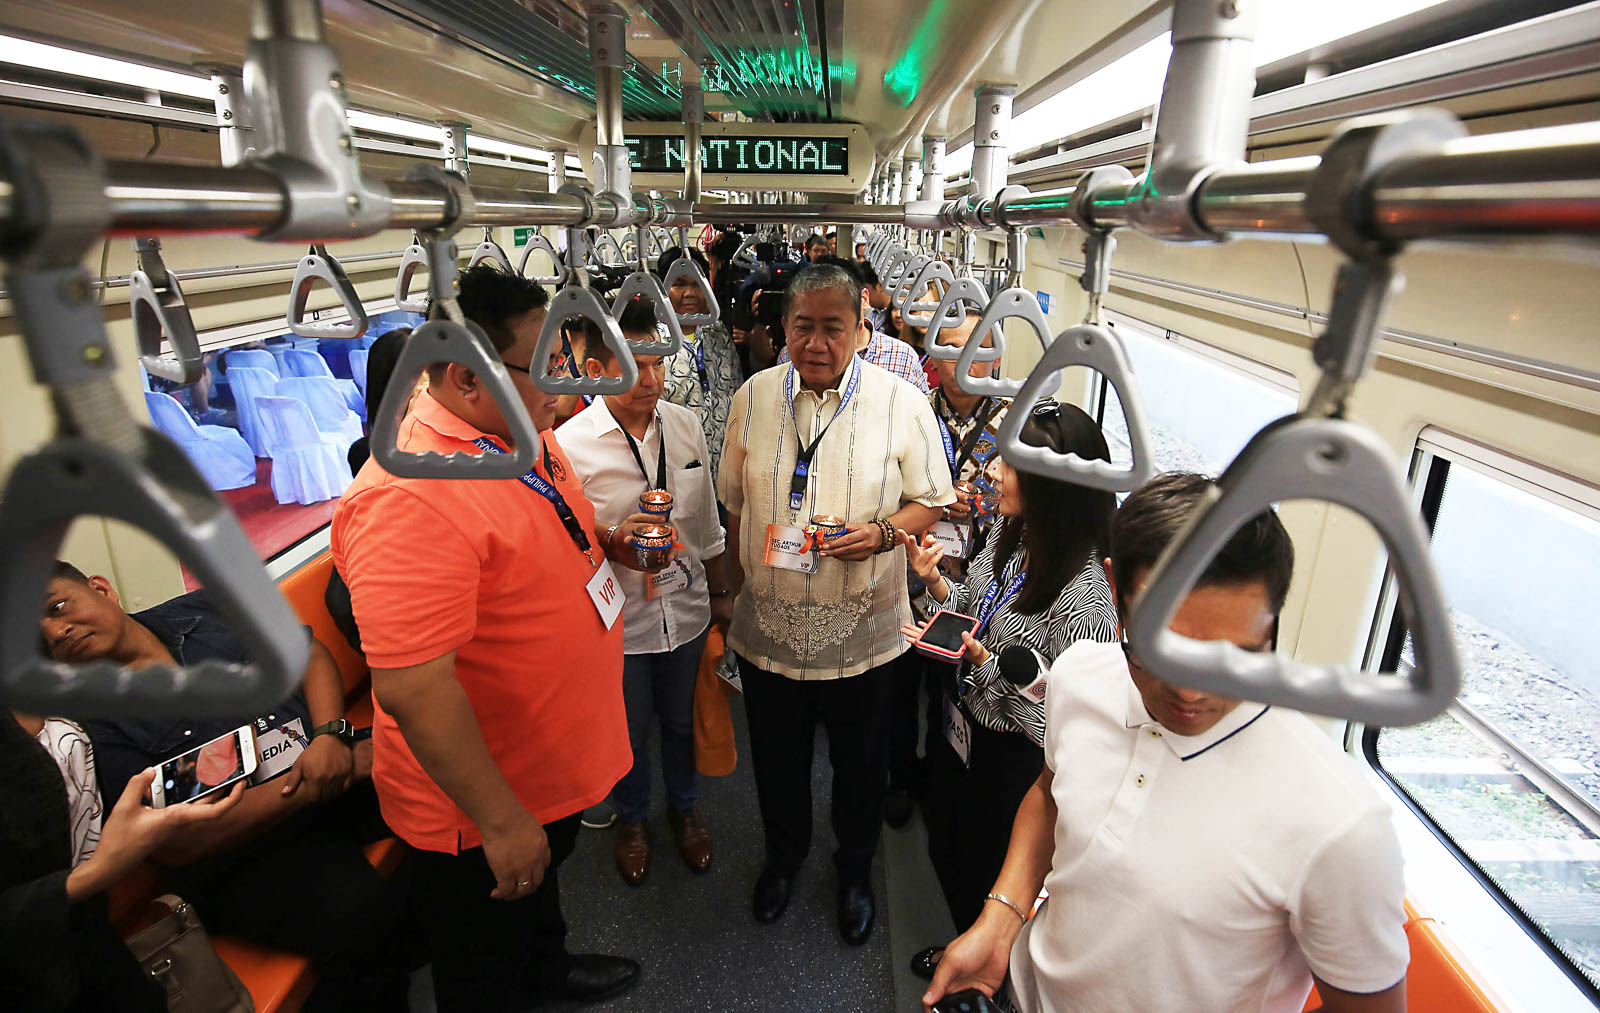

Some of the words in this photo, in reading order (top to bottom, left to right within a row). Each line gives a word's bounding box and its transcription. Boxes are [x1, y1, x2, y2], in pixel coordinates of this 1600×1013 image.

[475, 438, 500, 455] ONAL
[521, 473, 550, 494] PHILIPP
[782, 540, 802, 548] ARTHUR
[599, 577, 616, 606] VIP
[951, 720, 964, 744] ASS
